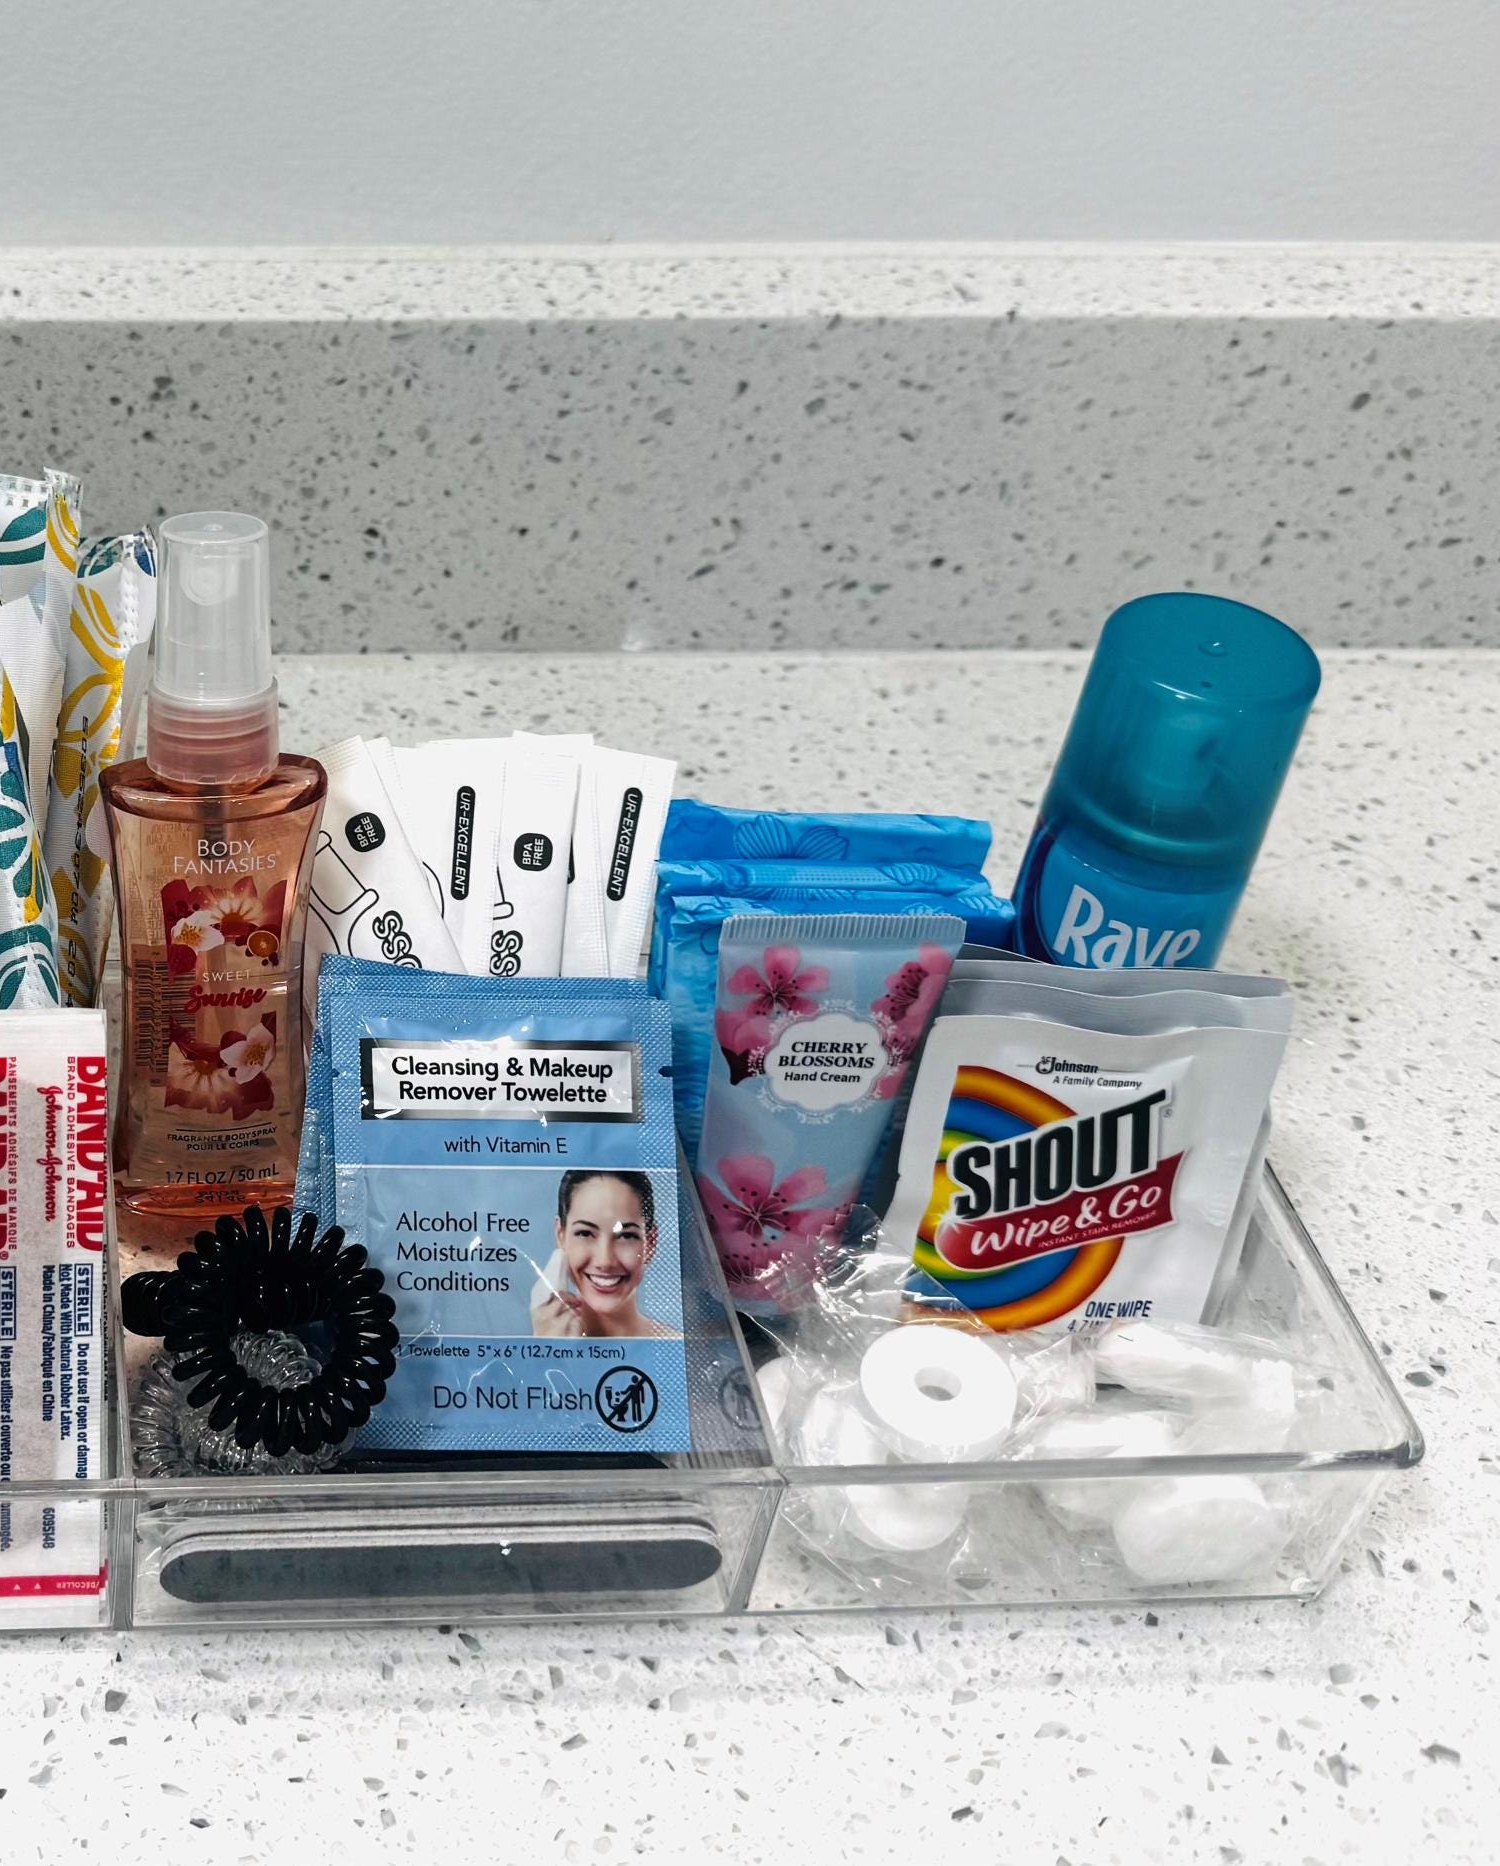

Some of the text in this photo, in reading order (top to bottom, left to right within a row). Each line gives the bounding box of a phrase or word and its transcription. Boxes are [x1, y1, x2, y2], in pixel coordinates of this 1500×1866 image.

[354, 825, 368, 848] BPA
[362, 815, 380, 843] FREE
[197, 839, 256, 857] BODY
[454, 791, 472, 895] UR-EXCELLENT
[522, 842, 532, 866] BPA
[533, 837, 544, 867] FREE
[610, 792, 640, 895] UR-EXCELLENT
[174, 853, 277, 875] FANTASIES
[1052, 884, 1201, 970] Rave
[202, 969, 251, 983] SWEET
[184, 985, 267, 1013] Sunrise
[791, 1041, 868, 1054] CHERRY
[391, 1056, 613, 1084] Cleansing & Makeup
[778, 1055, 875, 1069] BLOSSOMS
[1035, 1056, 1099, 1075] Johnson
[784, 1071, 861, 1083] Hand Cream
[1052, 1076, 1143, 1090] A Family Company
[399, 1081, 608, 1103] Remover Towelette
[167, 1126, 278, 1142] FRAGRANCE BODY SPRAY
[229, 1139, 260, 1150] CORPS
[444, 1136, 568, 1154] with Vitamin E
[8, 1056, 18, 1250] PANSEMENTS ADHÉSIFS DE MARQUE
[67, 1056, 76, 1249] BRAND ADHESIVE BANDAGES
[953, 1089, 1167, 1220] SHOUT
[166, 1171, 184, 1184] 1.7
[238, 1168, 255, 1182] 50
[258, 1163, 280, 1179] mL
[396, 1210, 530, 1233] Alcohol Free
[971, 1184, 1162, 1256] Wipe & Go
[1037, 1210, 1157, 1249] INSTANT STAIN REMOVER
[397, 1241, 518, 1262] Moisturizes
[42, 1265, 55, 1292] Made
[396, 1271, 510, 1292] Conditions
[1085, 1300, 1153, 1318] ONE WIPE
[59, 1264, 72, 1440] Not Made With Natural Rubber Latex.
[76, 1266, 90, 1431] STERILE Do not use open
[408, 1344, 470, 1357] Towelette
[494, 1349, 500, 1358] x
[520, 1345, 573, 1359] (12.7cm
[576, 1349, 584, 1358] x
[589, 1345, 626, 1360] 15cm)
[0, 1346, 13, 1462] Ne pas utiliser ouverte
[42, 1394, 55, 1422] Chine
[434, 1386, 593, 1410] Do Not Flush
[42, 1507, 56, 1549] 6095148
